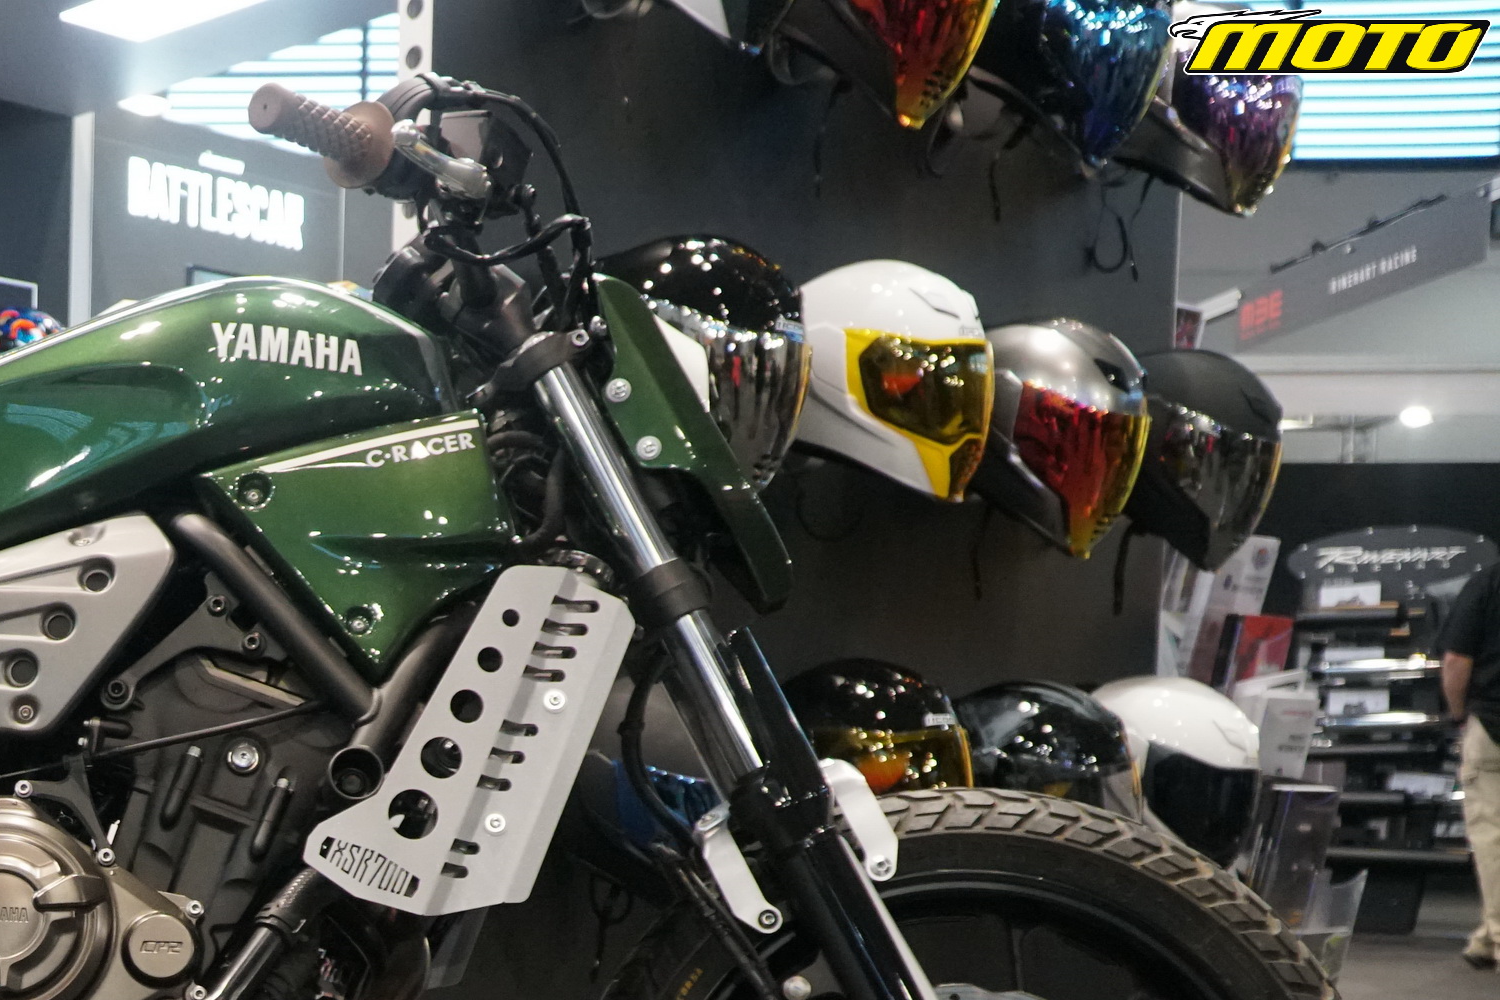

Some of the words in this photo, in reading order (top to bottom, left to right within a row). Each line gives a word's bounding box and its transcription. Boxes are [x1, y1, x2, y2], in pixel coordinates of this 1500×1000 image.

[127, 156, 304, 251] BATTLESCAR
[211, 322, 363, 376] YAMAHA
[329, 839, 410, 895] XSR700
